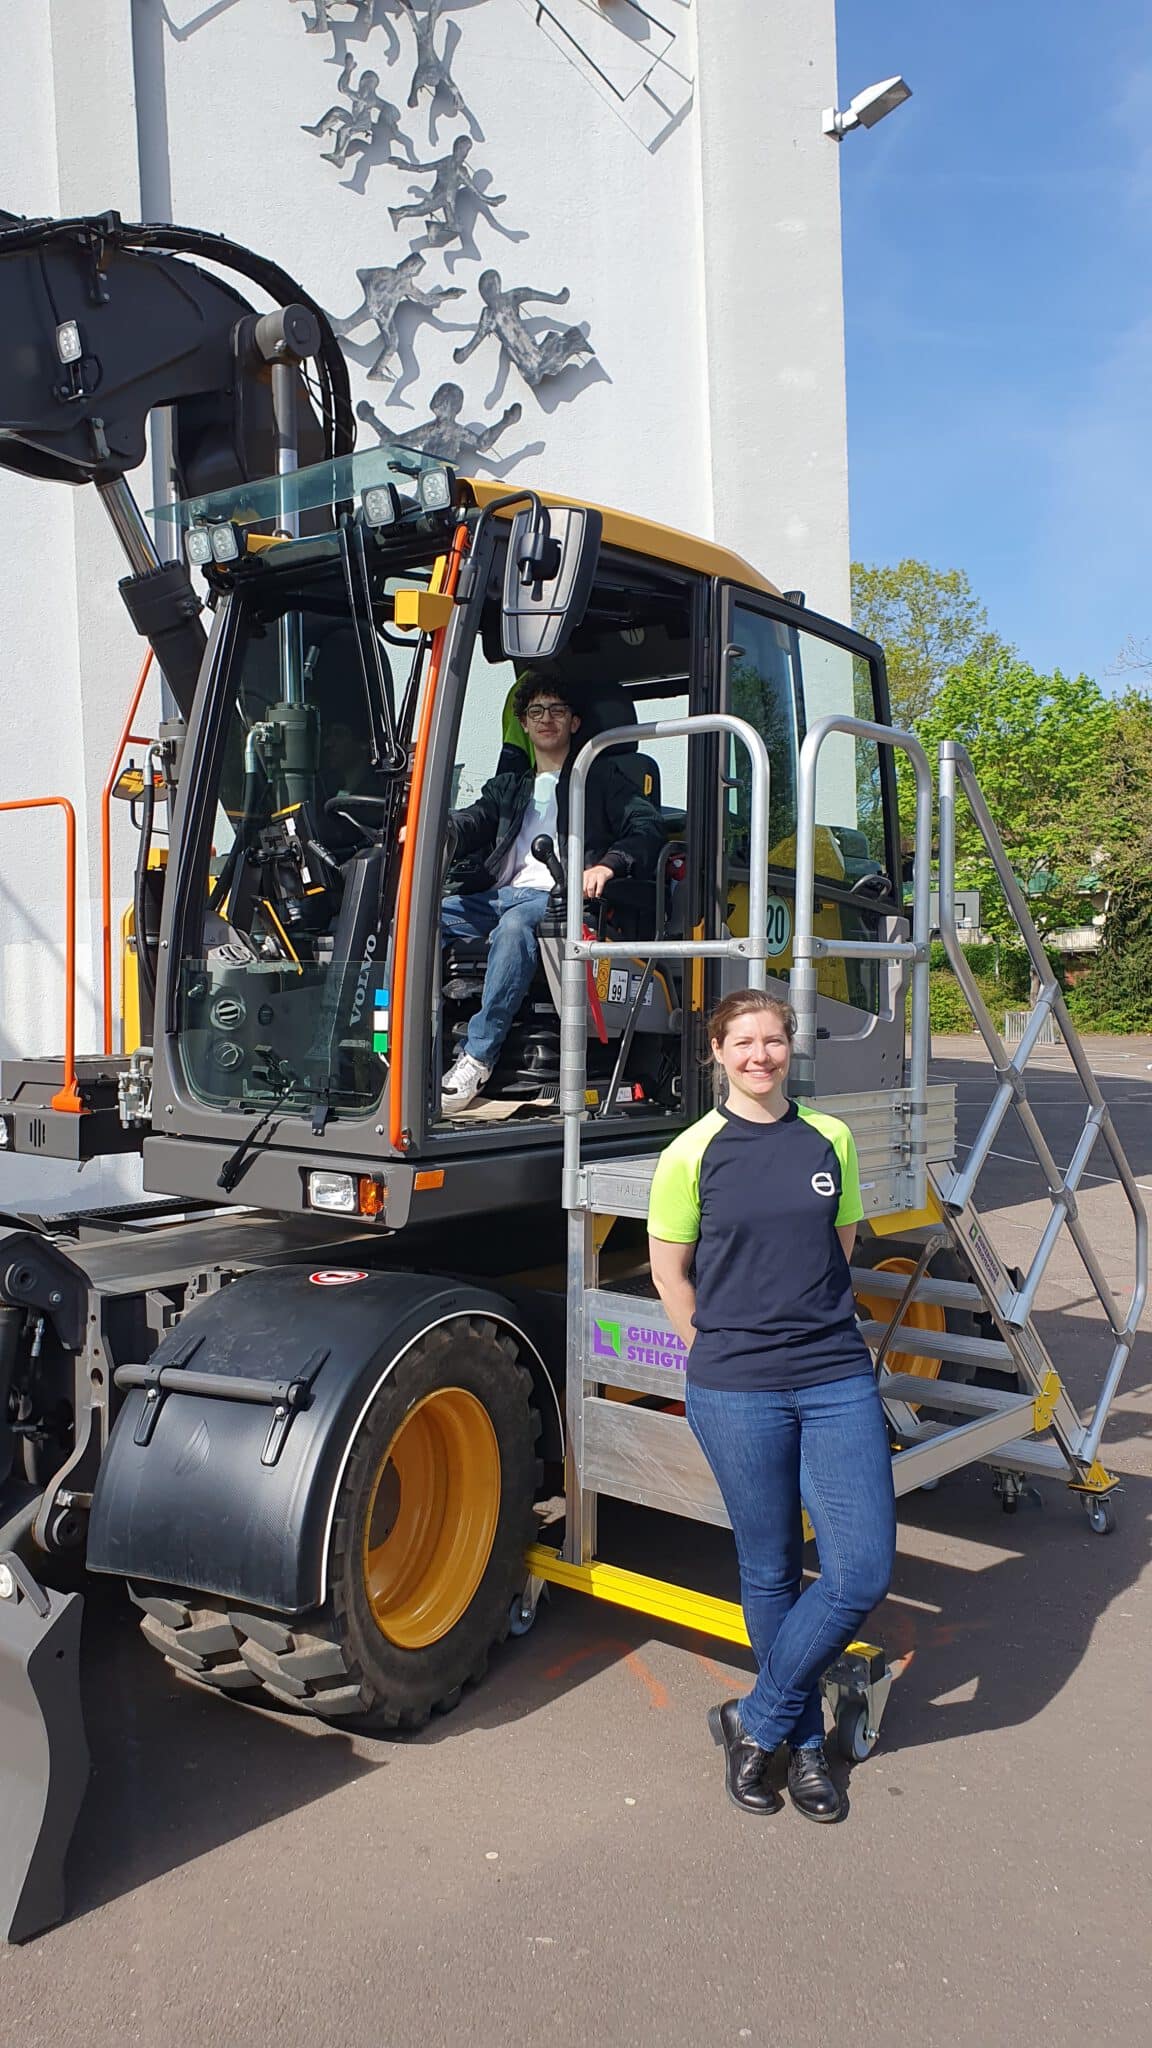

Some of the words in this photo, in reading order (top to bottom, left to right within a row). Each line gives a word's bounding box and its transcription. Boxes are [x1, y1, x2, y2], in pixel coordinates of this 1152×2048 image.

[767, 904, 785, 944] 20
[350, 934, 377, 1026] VOLVO
[612, 984, 622, 1000] 99
